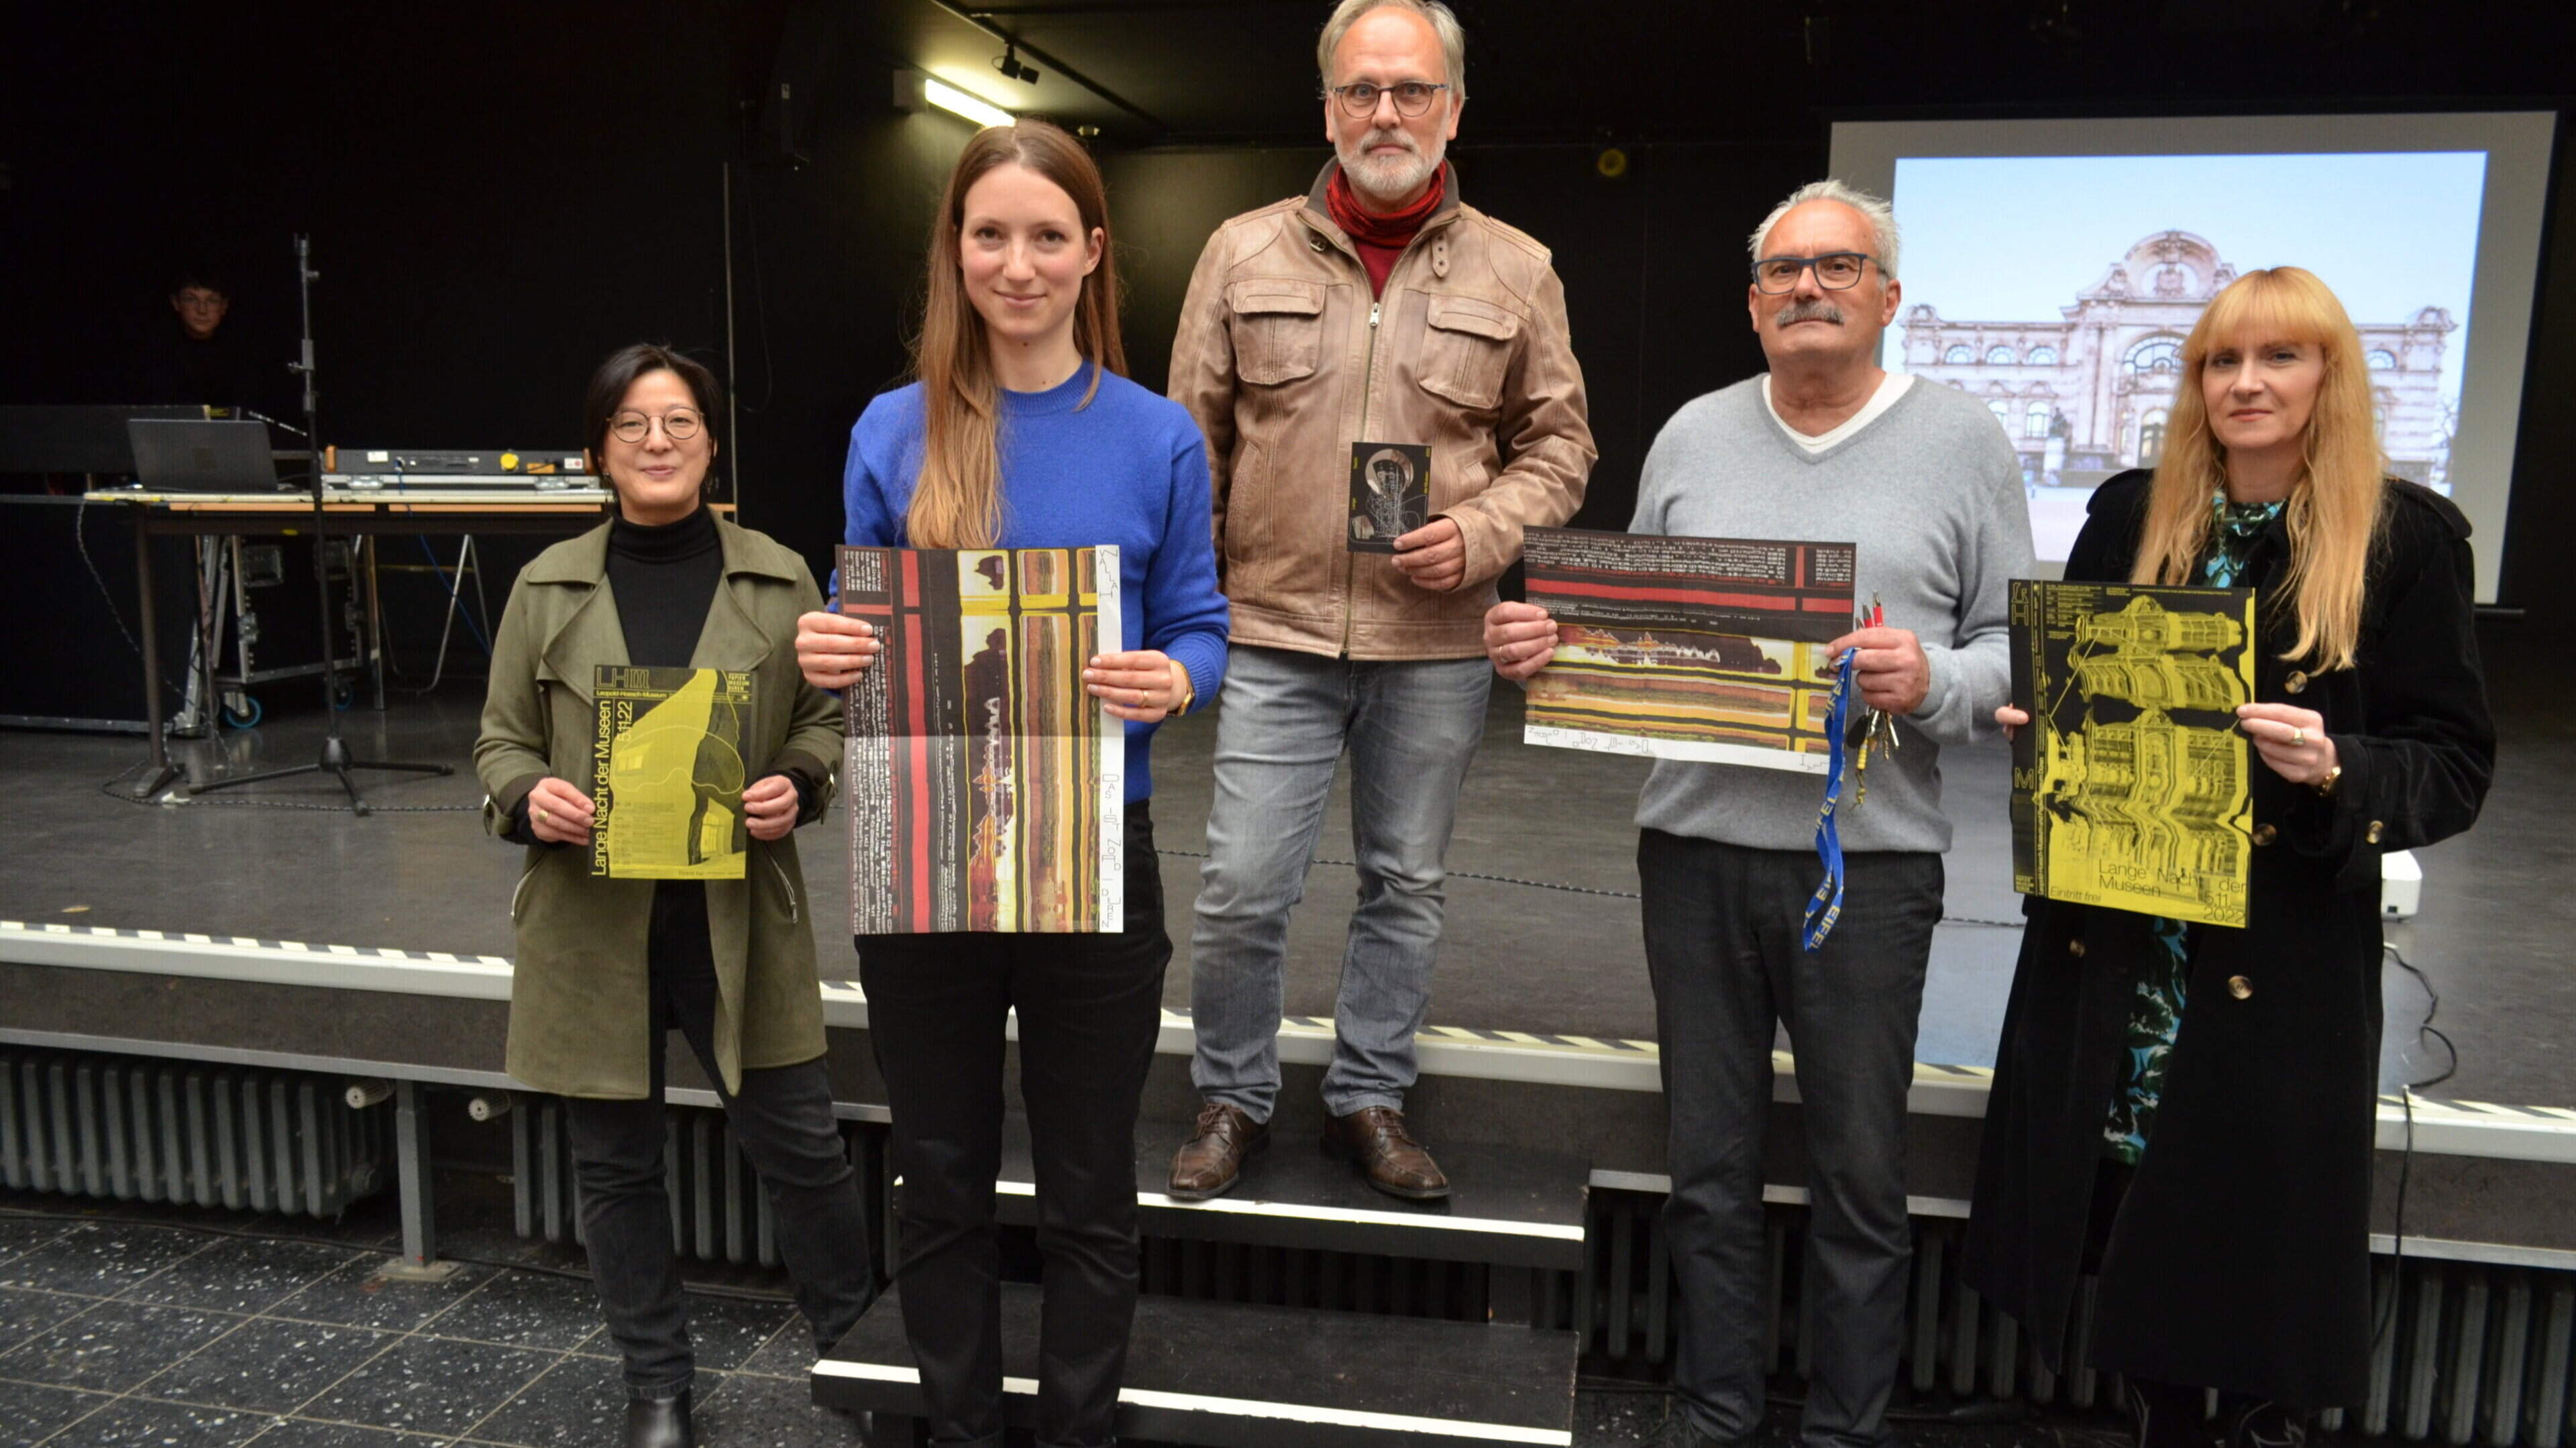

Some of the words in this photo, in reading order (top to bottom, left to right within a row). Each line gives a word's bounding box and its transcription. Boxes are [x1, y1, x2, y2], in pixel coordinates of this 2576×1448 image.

[594, 700, 612, 758] Museen
[594, 760, 610, 785] der
[593, 787, 609, 829] Nacht
[591, 831, 610, 875] Lange
[2099, 858, 2147, 881] Lange
[2157, 868, 2204, 888] Nacht
[2218, 878, 2247, 893] der
[2099, 874, 2161, 897] Museen
[2085, 890, 2102, 903] frei
[2203, 905, 2248, 925] 2022
